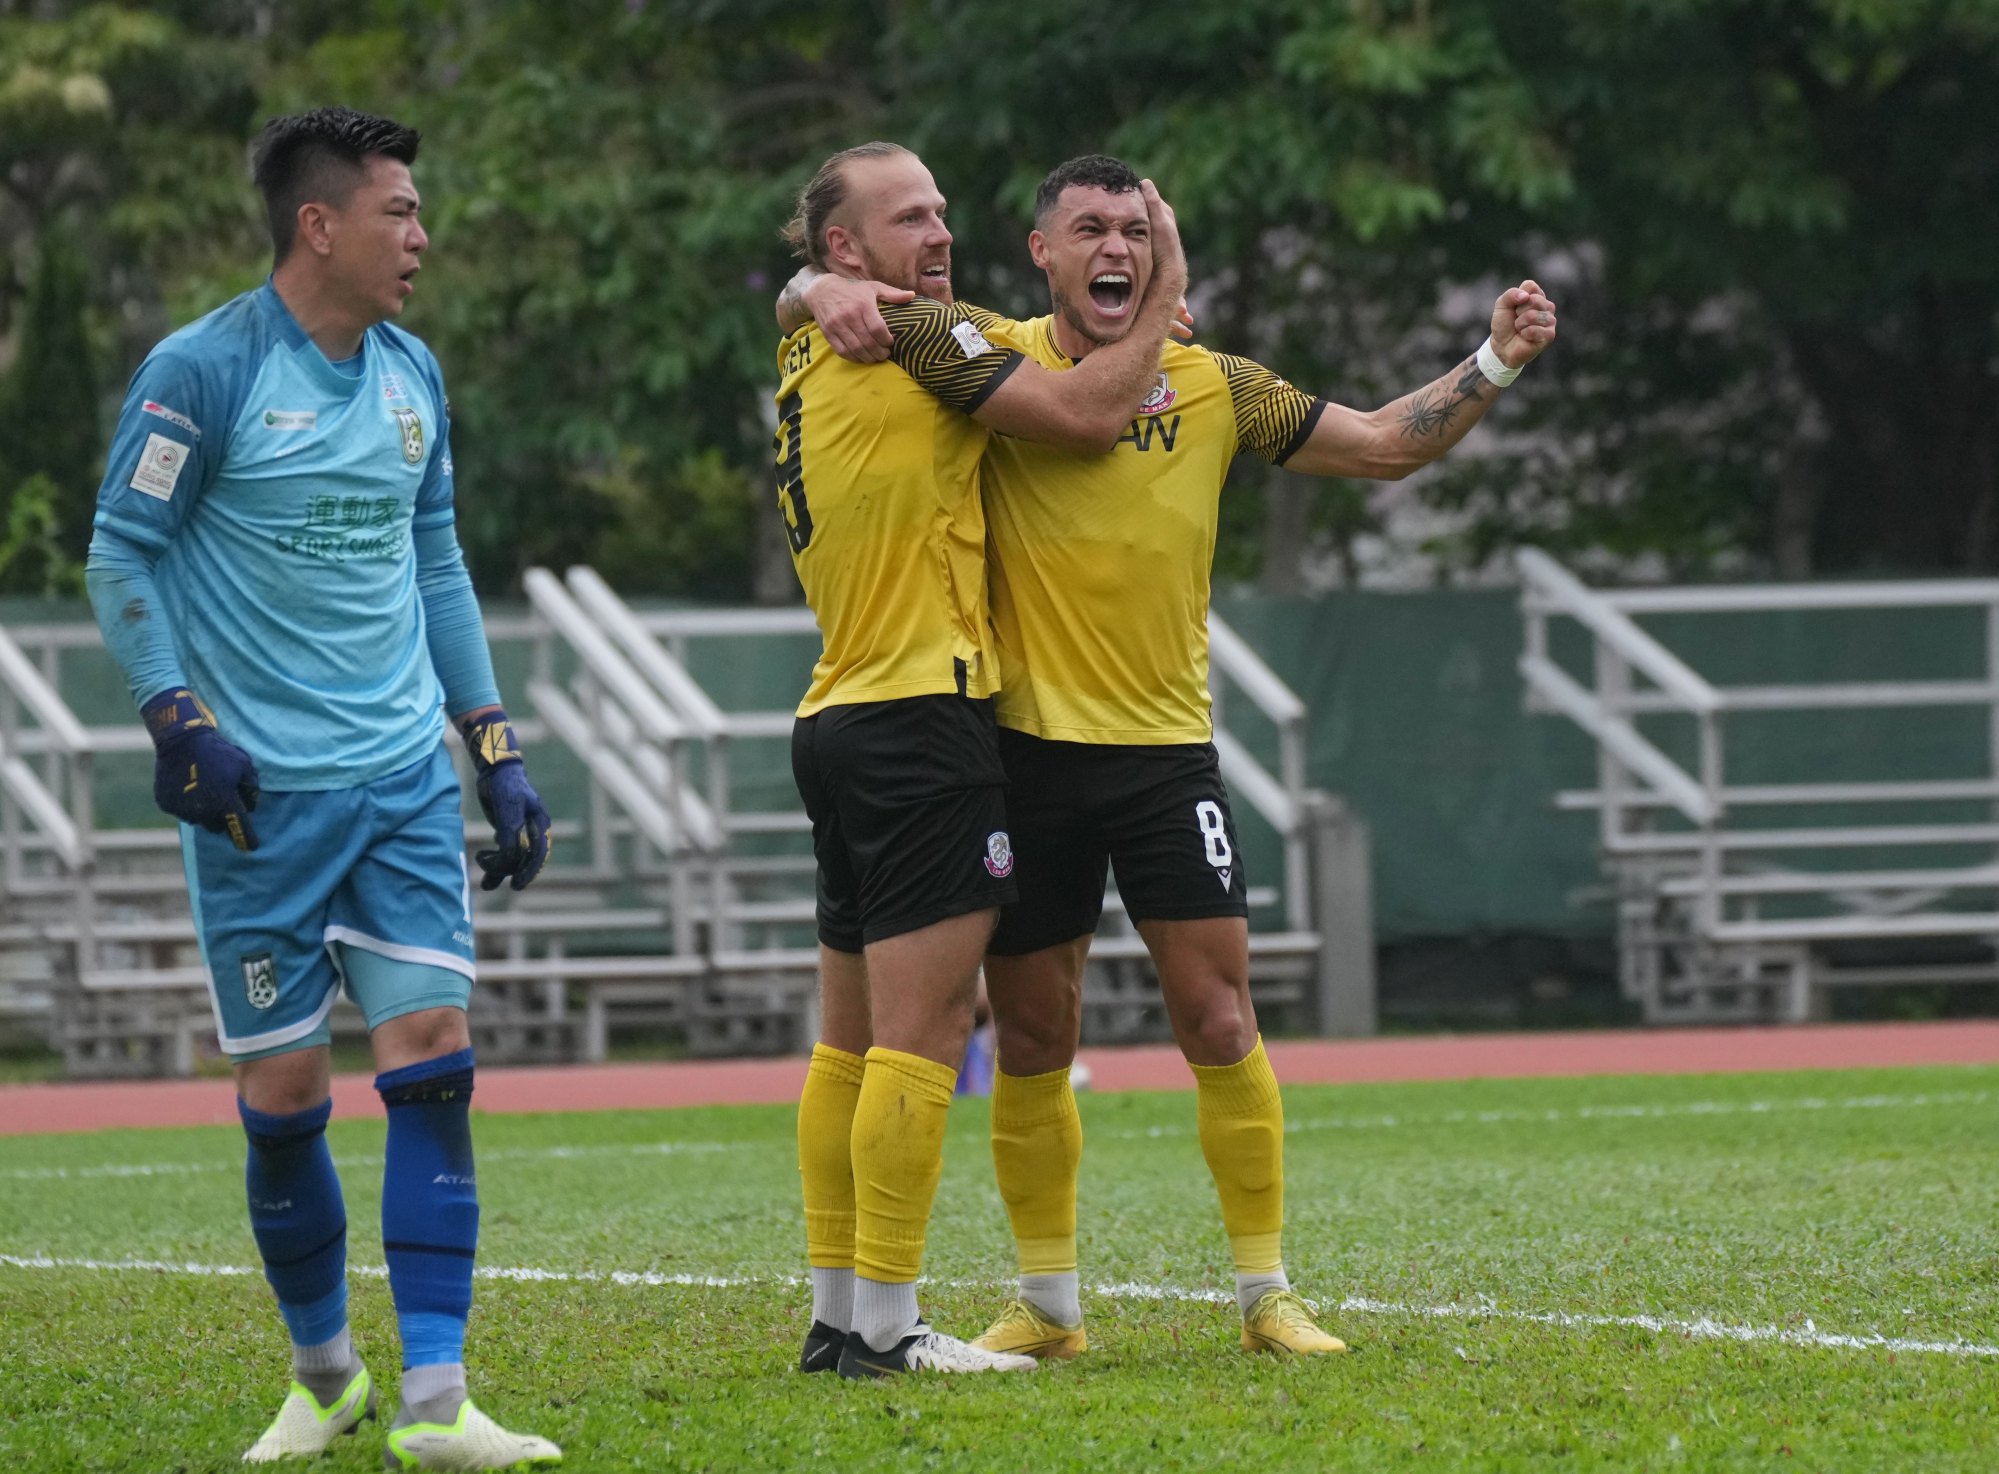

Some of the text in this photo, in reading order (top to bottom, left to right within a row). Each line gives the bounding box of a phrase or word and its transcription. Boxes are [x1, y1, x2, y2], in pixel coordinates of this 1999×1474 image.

[303, 495, 400, 529] 運動家
[1196, 801, 1232, 867] 8
